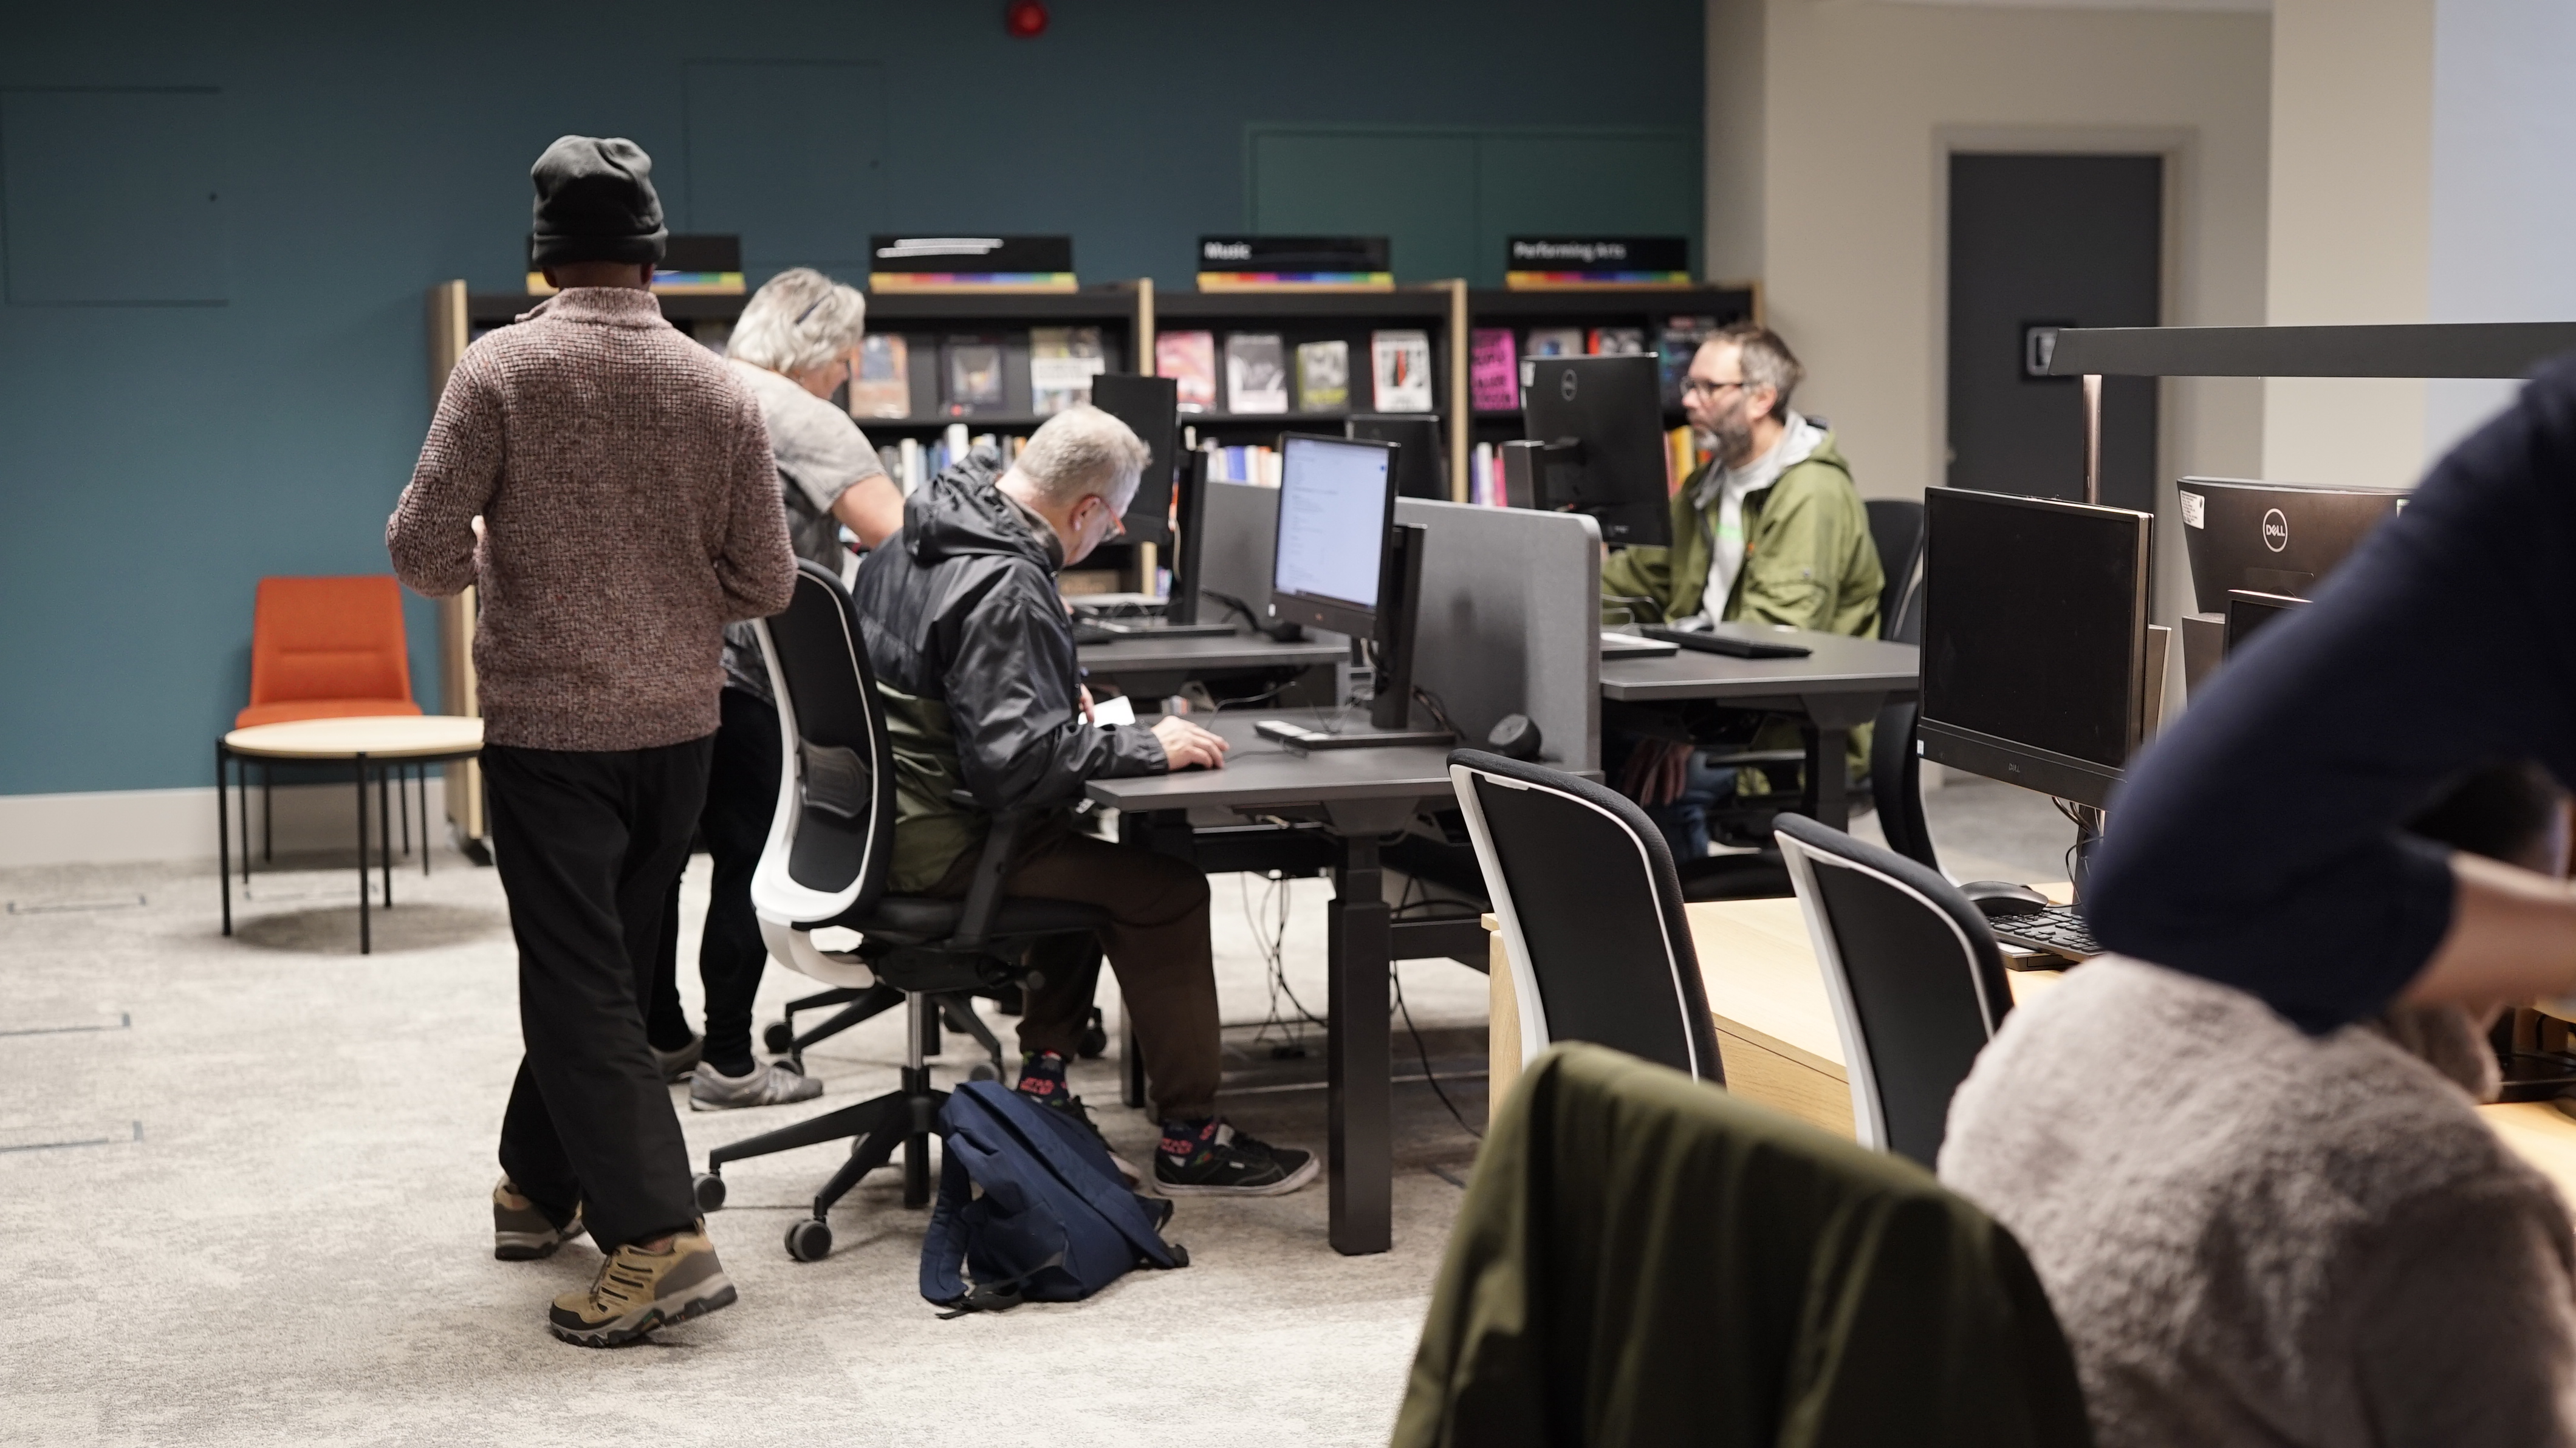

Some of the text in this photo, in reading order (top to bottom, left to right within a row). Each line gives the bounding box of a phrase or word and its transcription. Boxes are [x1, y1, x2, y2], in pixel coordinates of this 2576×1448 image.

[1204, 241, 1252, 260] Music
[1513, 241, 1626, 263] Performing Arts
[2266, 524, 2286, 537] DELL
[2009, 763, 2020, 773] DELL
